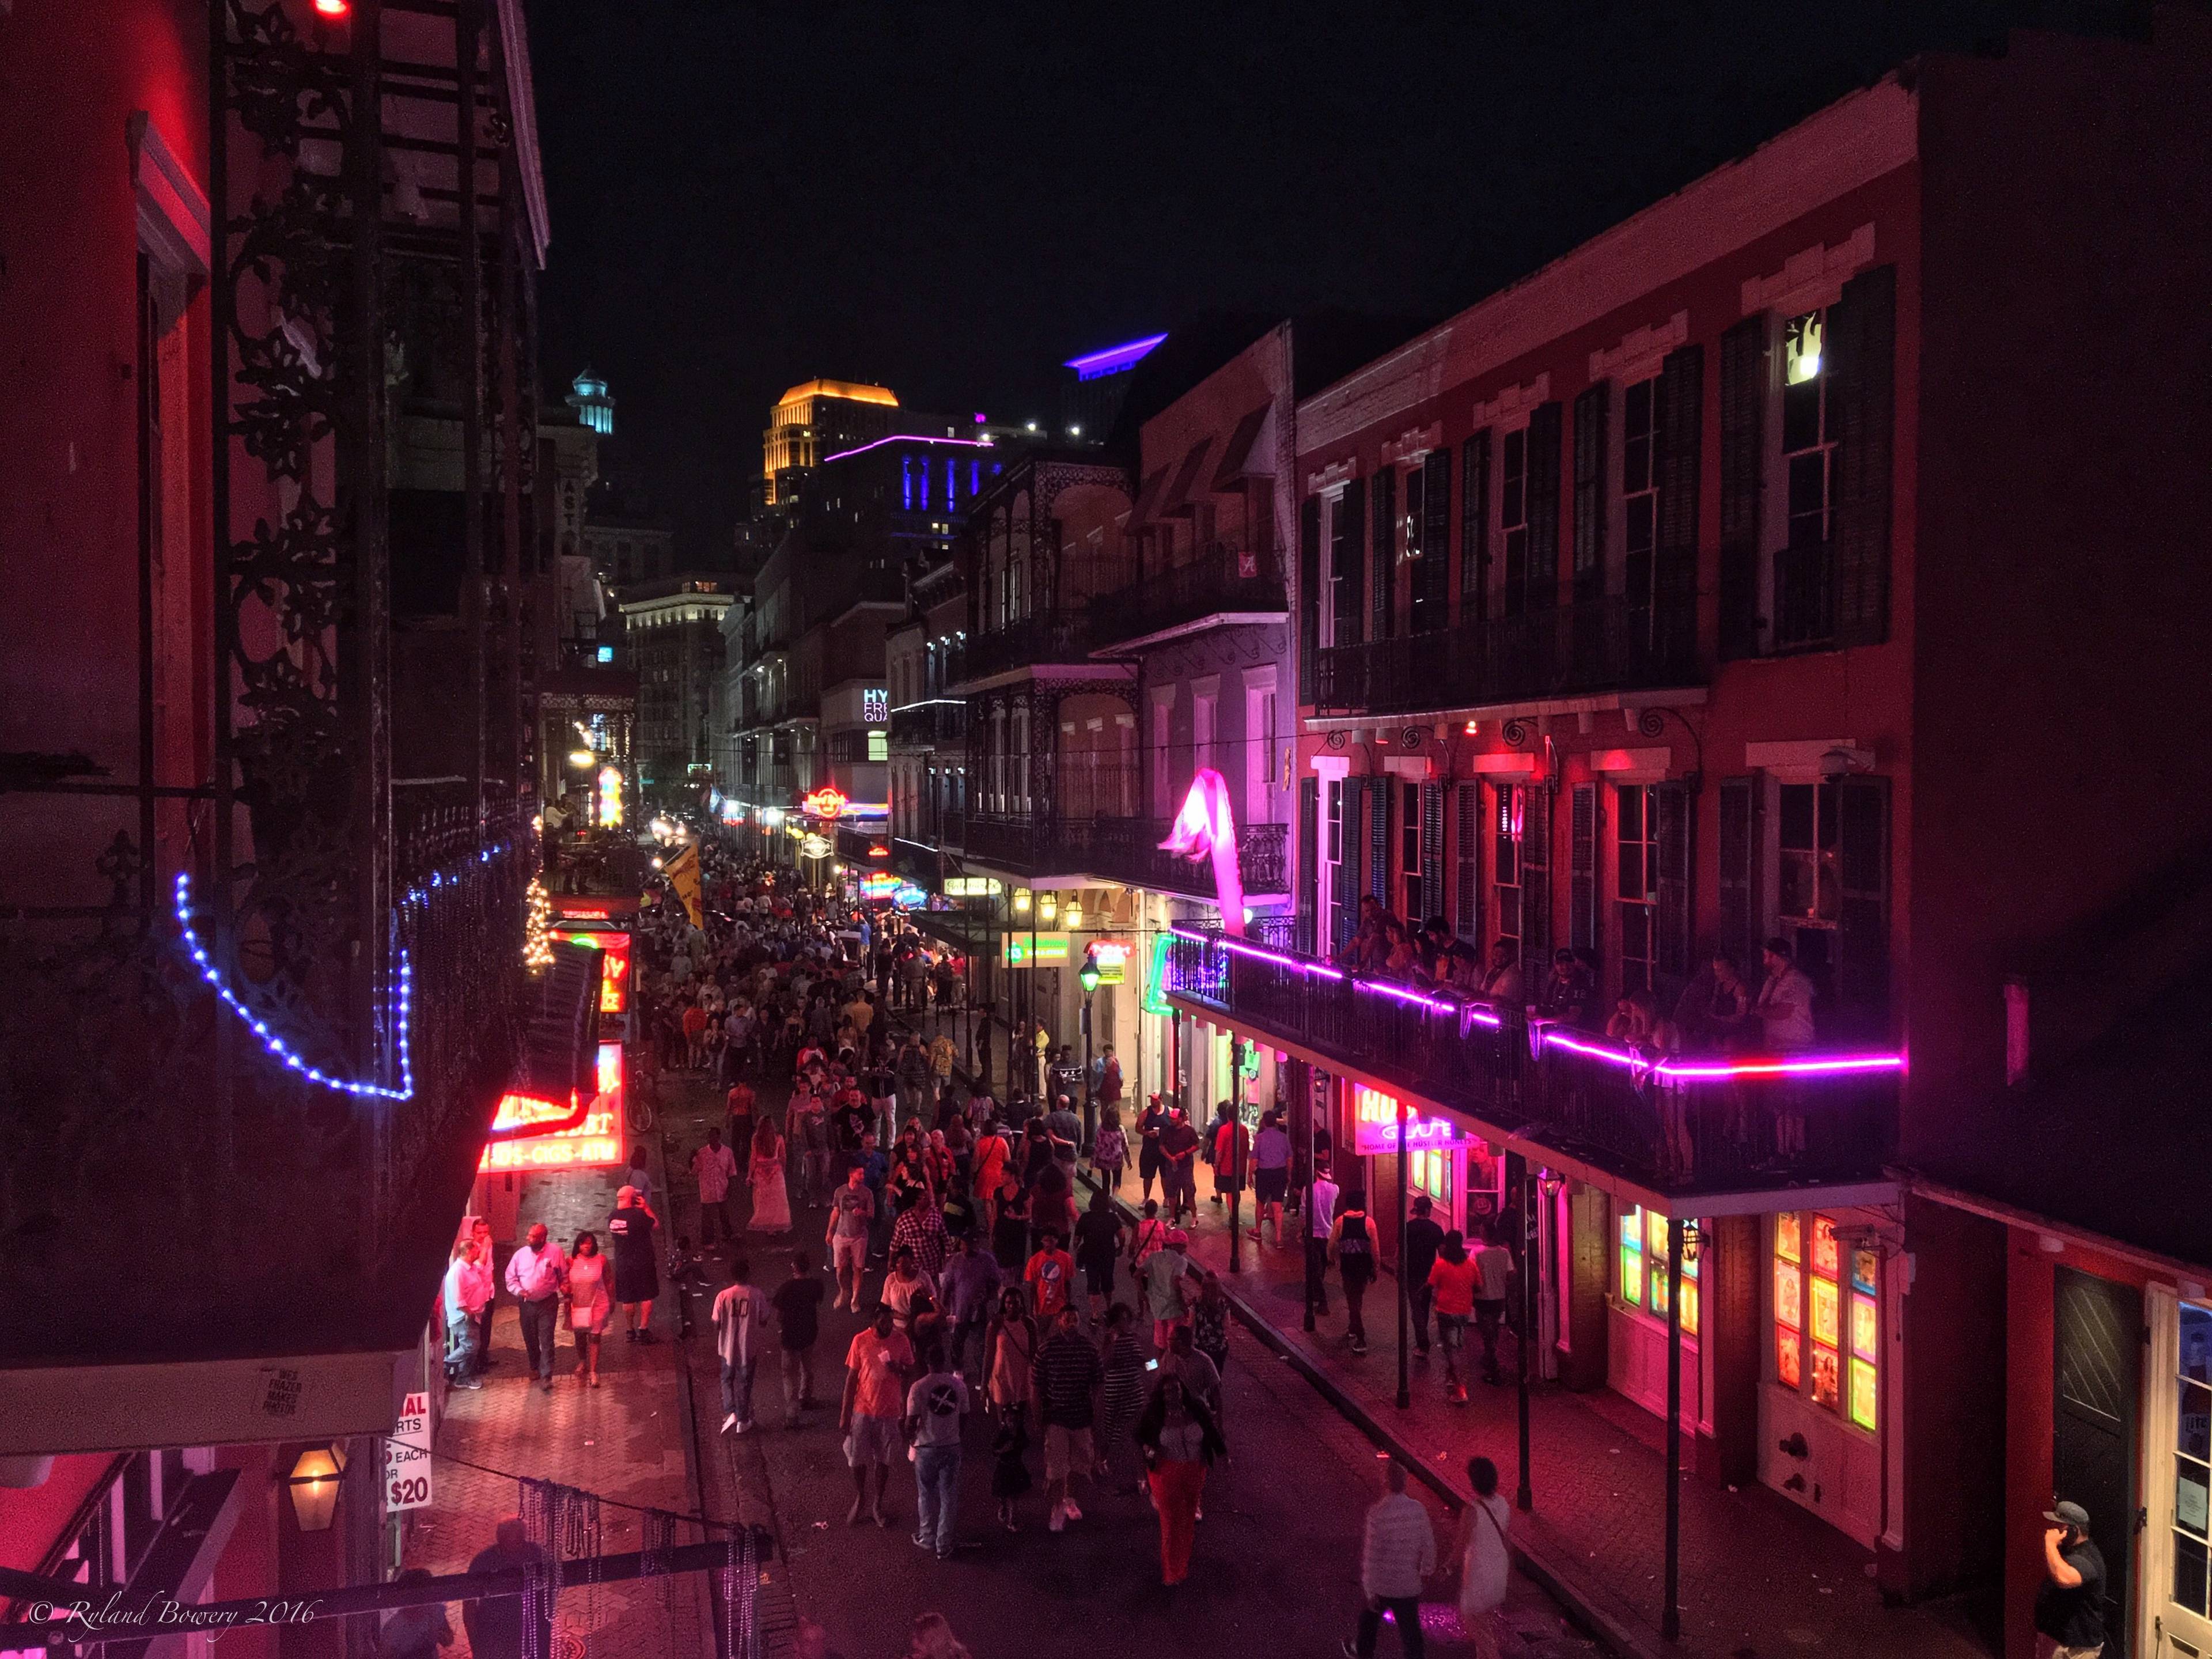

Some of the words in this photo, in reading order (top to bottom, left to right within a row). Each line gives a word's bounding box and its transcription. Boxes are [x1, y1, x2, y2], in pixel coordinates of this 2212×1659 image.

[864, 689, 888, 703] HY
[396, 1448, 427, 1463] EACH
[391, 1476, 428, 1506] $20
